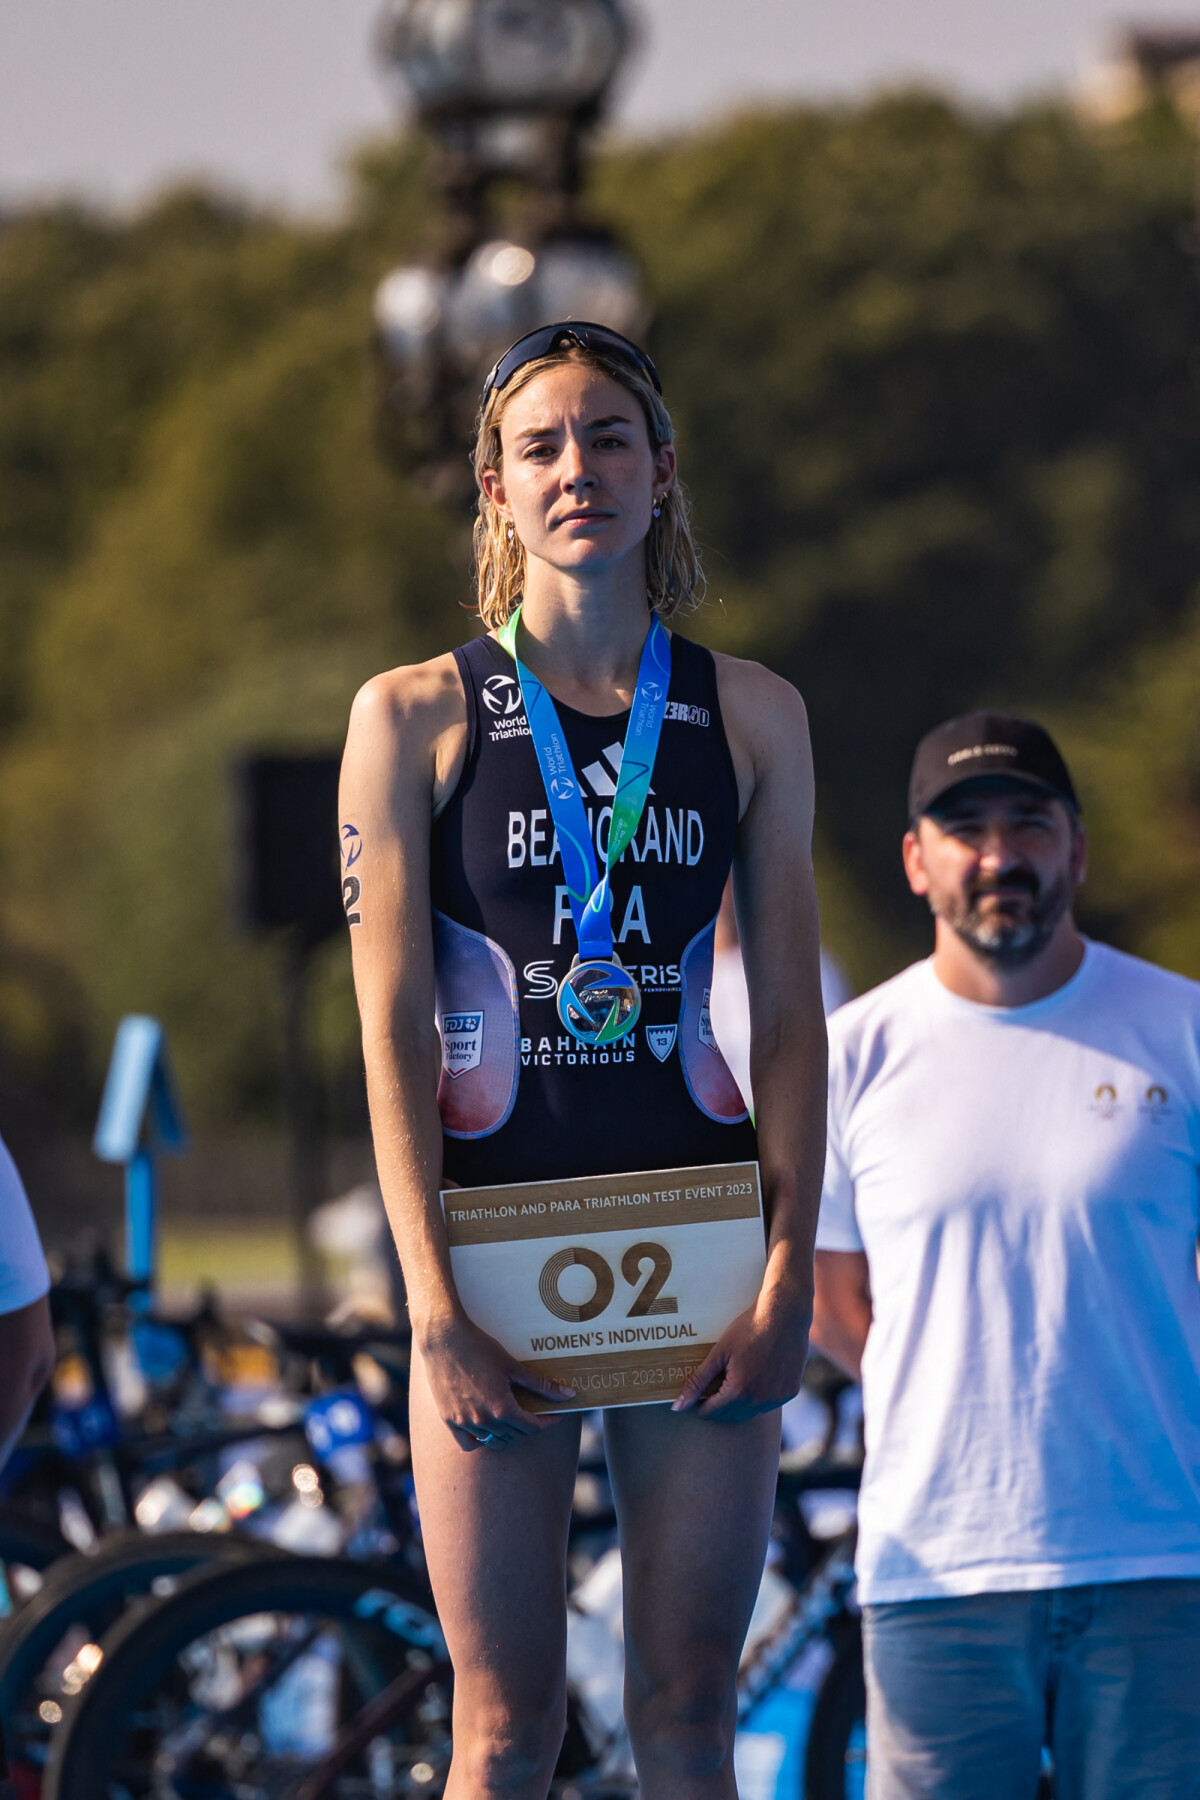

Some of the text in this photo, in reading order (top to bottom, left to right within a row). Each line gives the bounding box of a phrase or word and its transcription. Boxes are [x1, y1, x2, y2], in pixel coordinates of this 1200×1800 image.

[493, 715, 527, 730] World
[635, 702, 650, 736] Triathlon
[646, 704, 658, 729] World
[543, 746, 557, 776] World
[550, 733, 567, 775] Triathlon
[445, 1018, 464, 1031] FDJ
[444, 1038, 477, 1054] Sport
[656, 1037, 668, 1046] 13
[521, 1050, 635, 1066] VICTORIOUS
[450, 1182, 753, 1222] TRIATHLON AND PARA TRIATHLON TEST EVENT 2023
[530, 1323, 698, 1352] WOMEN'S INDIVIDUAL
[571, 1371, 628, 1391] AUGUST
[632, 1368, 665, 1385] 2023
